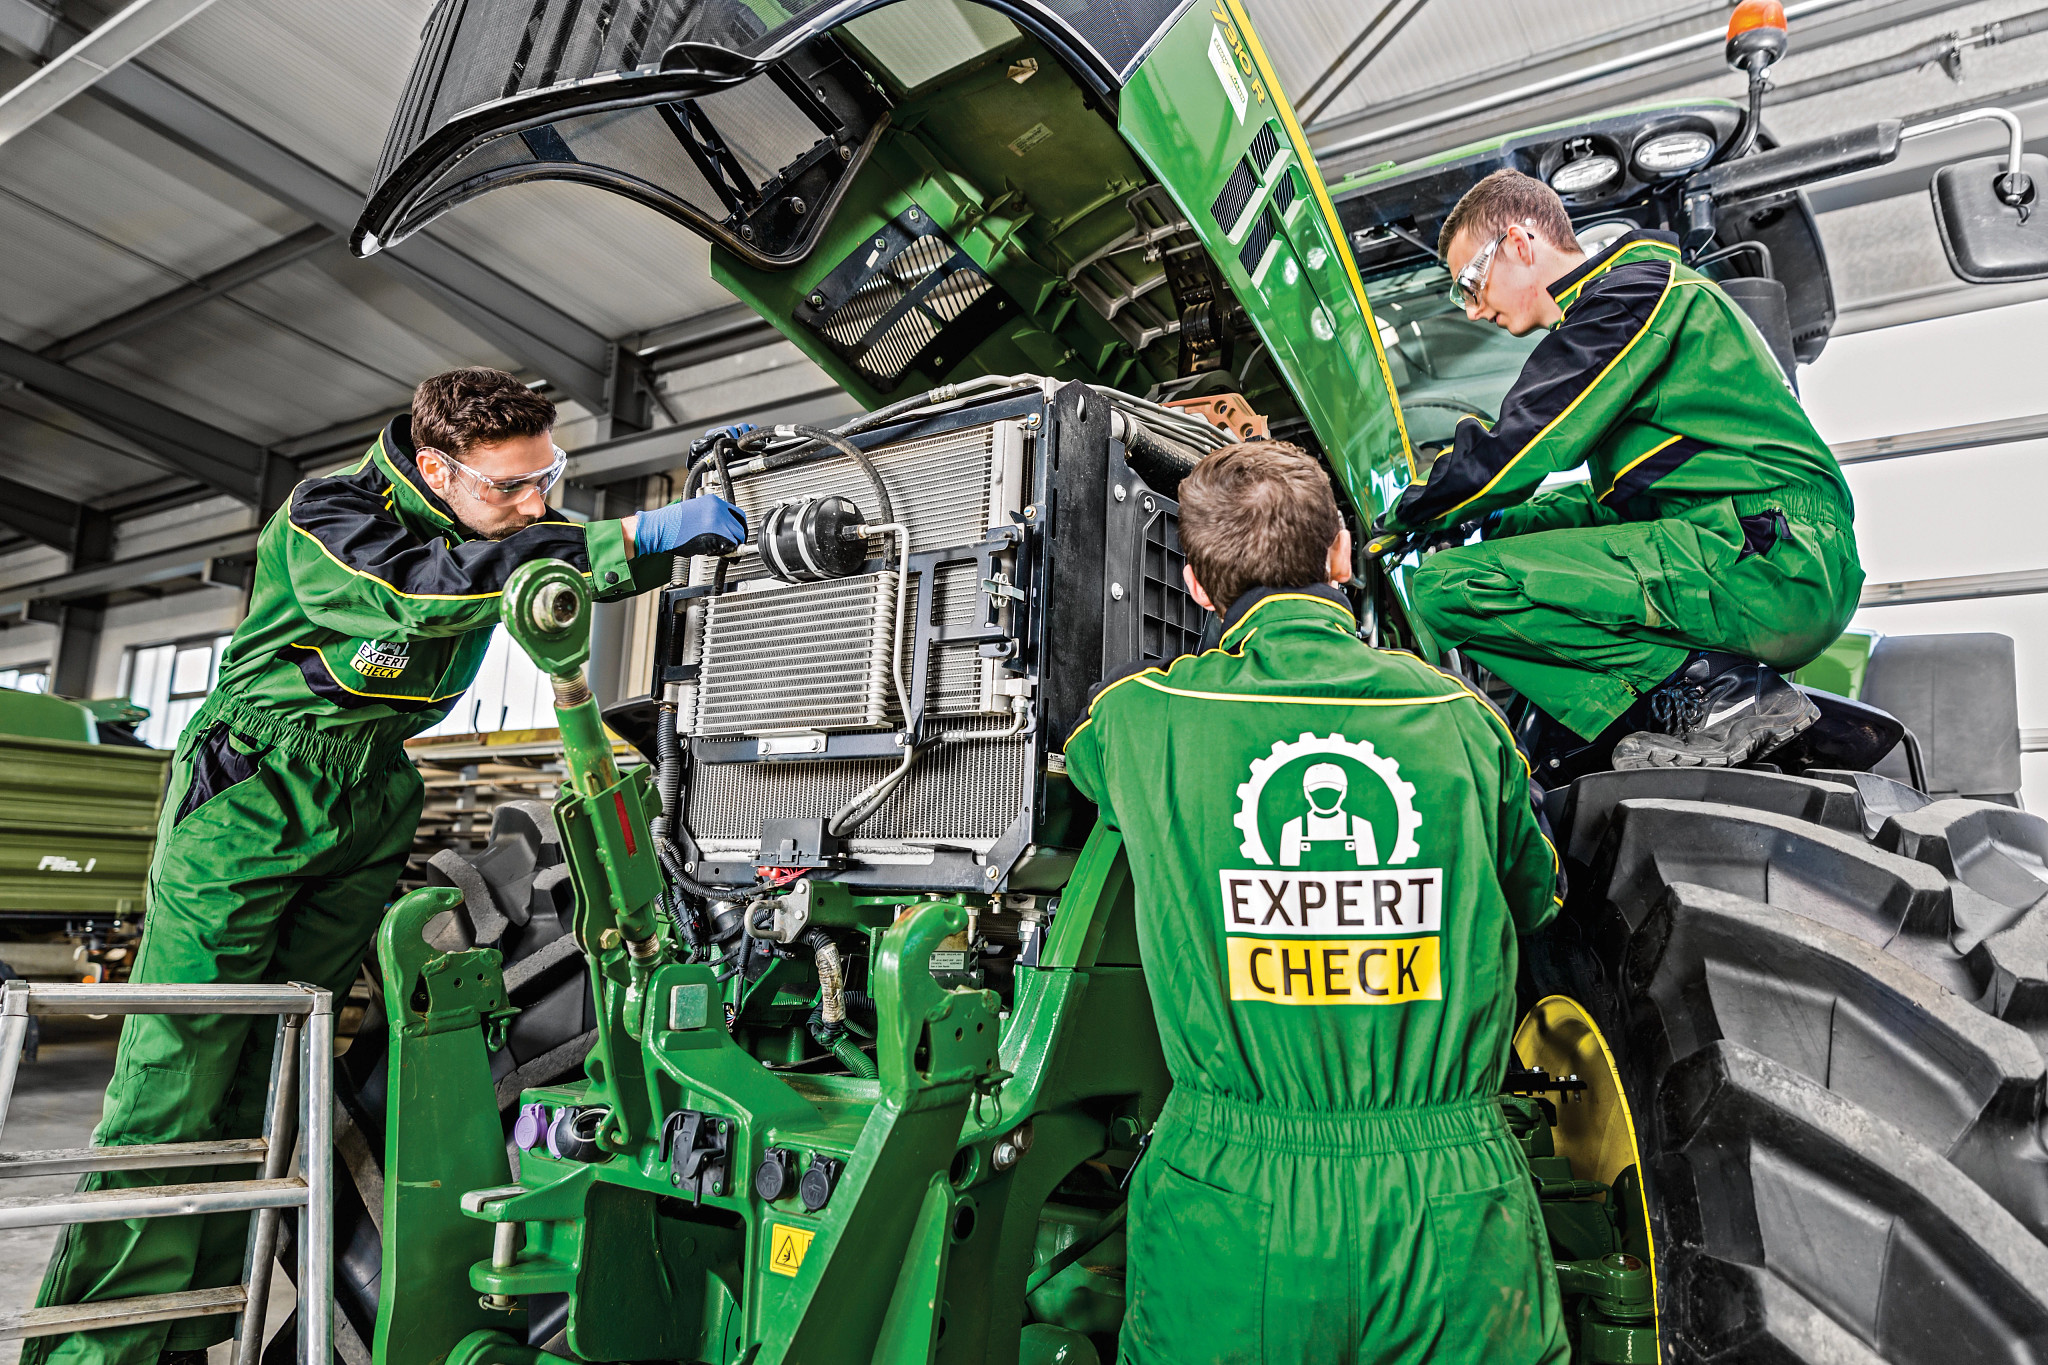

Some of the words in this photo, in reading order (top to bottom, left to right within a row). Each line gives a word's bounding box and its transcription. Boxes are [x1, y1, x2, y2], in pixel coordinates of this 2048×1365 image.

[1211, 0, 1252, 77] 7310
[1251, 78, 1266, 106] R
[355, 659, 398, 678] CHECK
[360, 644, 408, 668] EXPERT
[1229, 879, 1434, 926] EXPERT
[1250, 946, 1420, 996] CHECK
